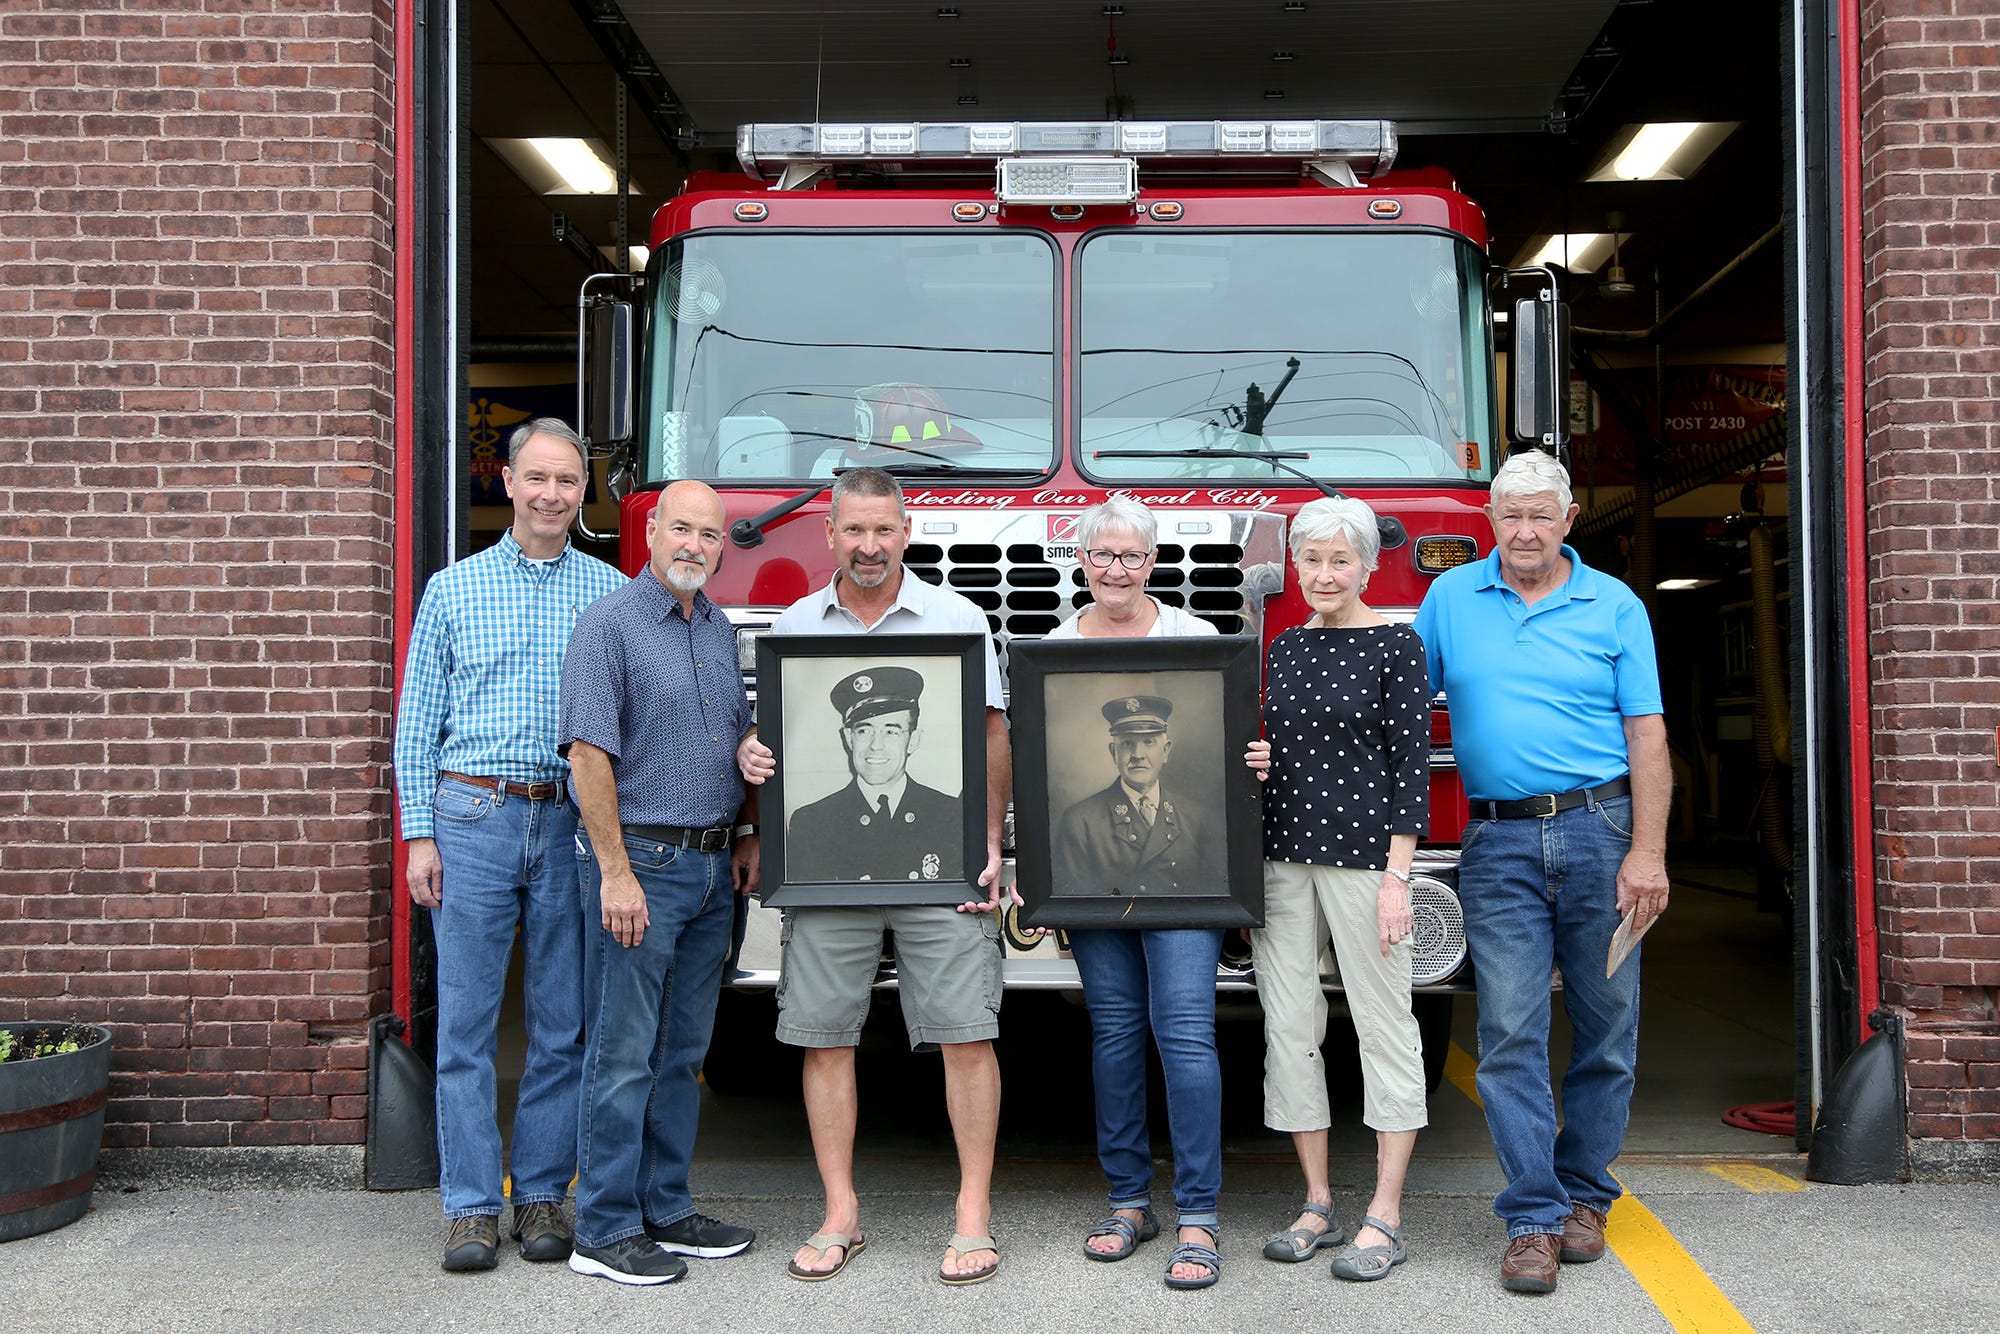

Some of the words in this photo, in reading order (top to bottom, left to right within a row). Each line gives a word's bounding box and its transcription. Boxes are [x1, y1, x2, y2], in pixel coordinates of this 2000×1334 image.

[1664, 417, 1703, 430] POST
[1709, 416, 1746, 430] 2430
[1465, 447, 1474, 461] 9
[470, 462, 504, 473] GETH
[903, 490, 1016, 510] otecting
[1033, 489, 1088, 505] Our
[1106, 489, 1197, 505] Great
[1207, 489, 1279, 510] City
